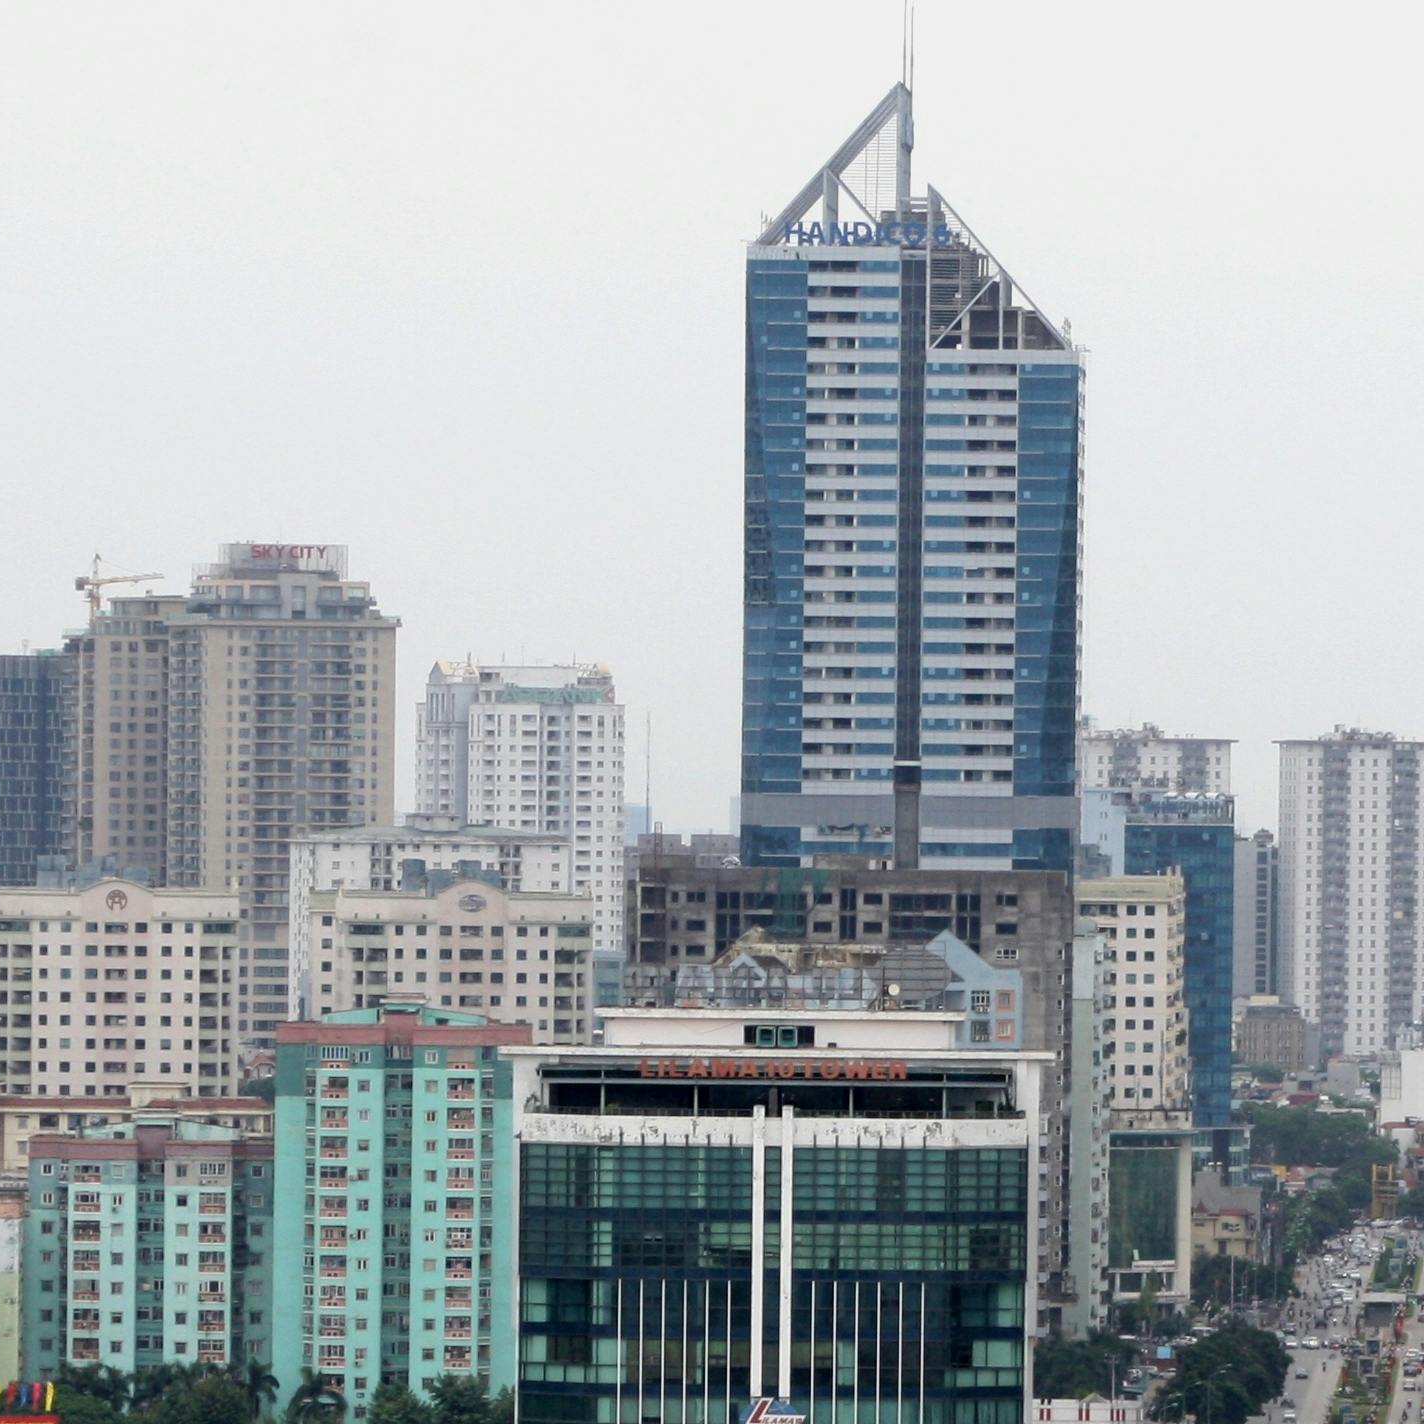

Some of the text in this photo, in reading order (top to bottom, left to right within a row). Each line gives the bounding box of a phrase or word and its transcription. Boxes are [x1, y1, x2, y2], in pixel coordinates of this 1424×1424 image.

[251, 545, 326, 558] SKY CITY
[640, 1058, 907, 1079] LILAMA 10 TOWER
